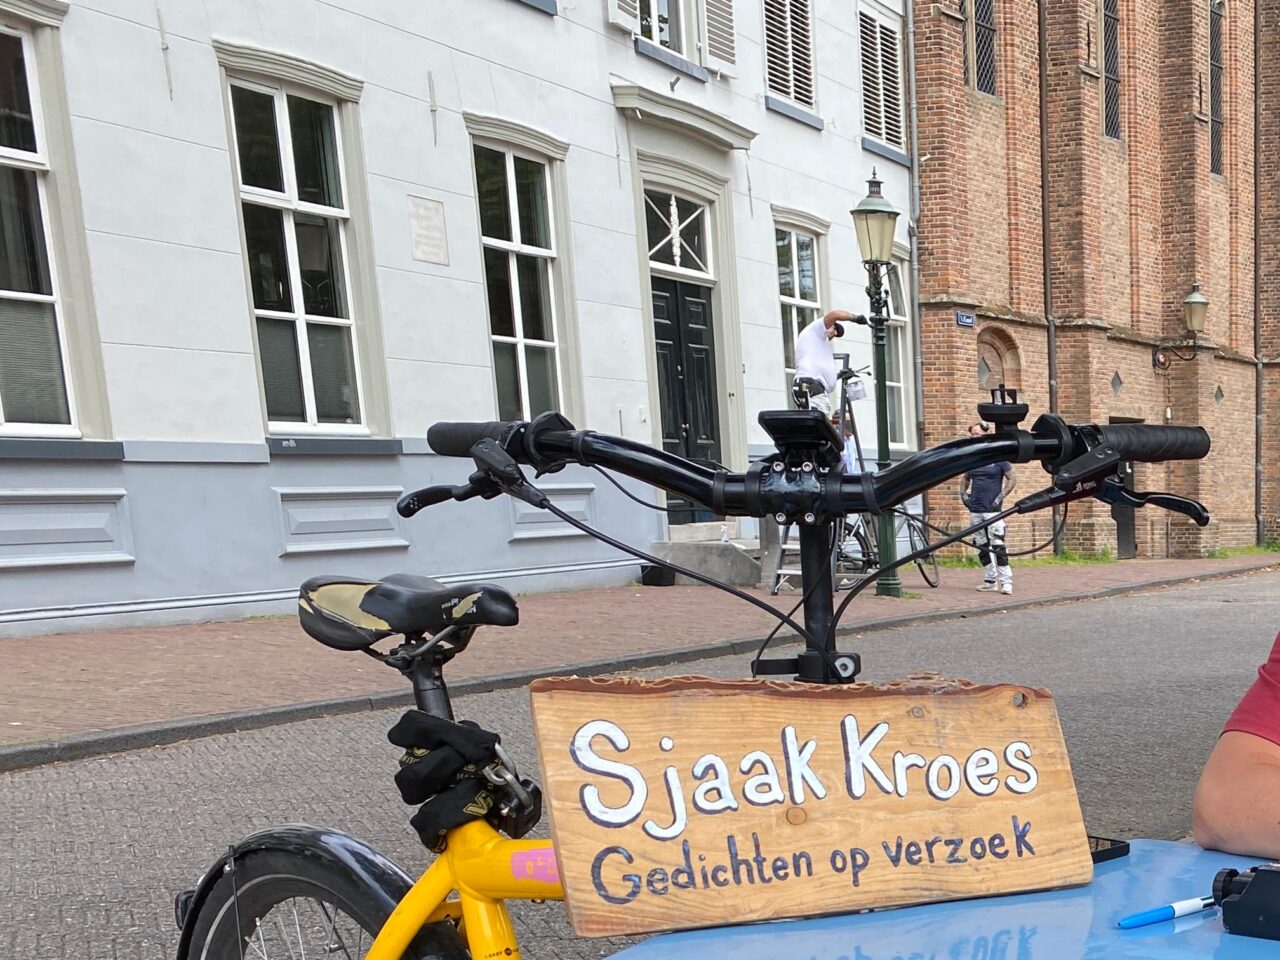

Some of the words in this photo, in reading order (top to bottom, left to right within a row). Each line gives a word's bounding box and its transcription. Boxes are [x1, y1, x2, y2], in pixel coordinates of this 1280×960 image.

[570, 719, 827, 842] Sjaak
[840, 713, 1039, 801] Kroes
[591, 832, 813, 904] Gedichten
[830, 847, 870, 887] op
[881, 815, 1036, 868] verzoek
